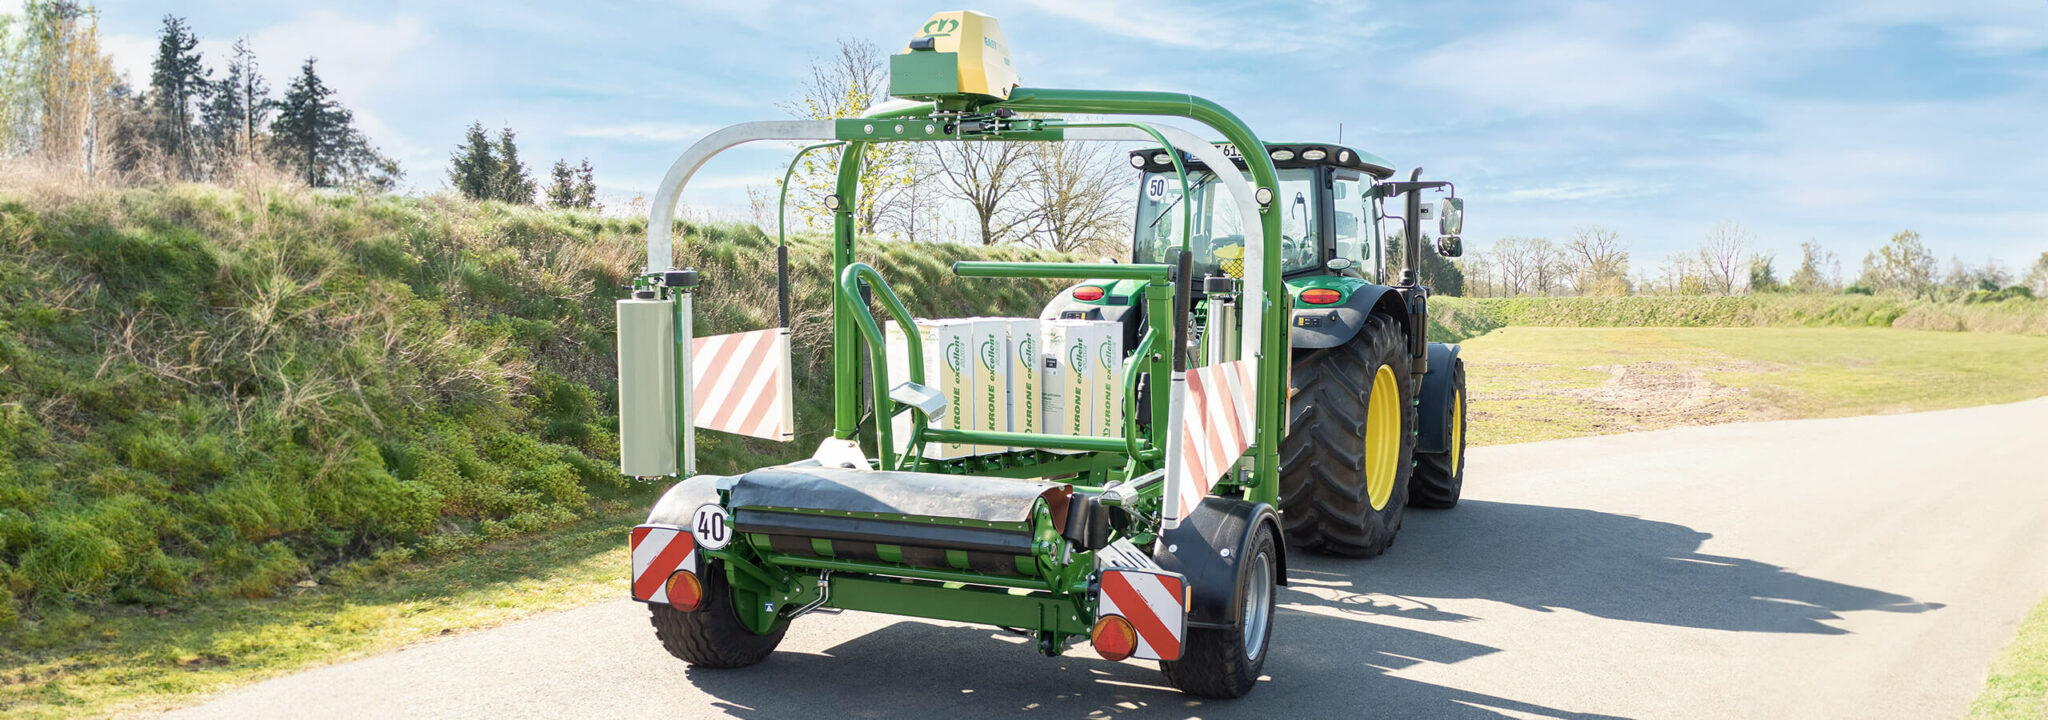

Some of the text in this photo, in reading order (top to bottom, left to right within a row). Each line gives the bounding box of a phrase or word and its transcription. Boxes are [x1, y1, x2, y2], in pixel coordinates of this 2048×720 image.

[1150, 179, 1164, 196] 50
[1025, 382, 1033, 427] KRONE
[1073, 387, 1082, 436] KRONE
[697, 511, 725, 542] 40
